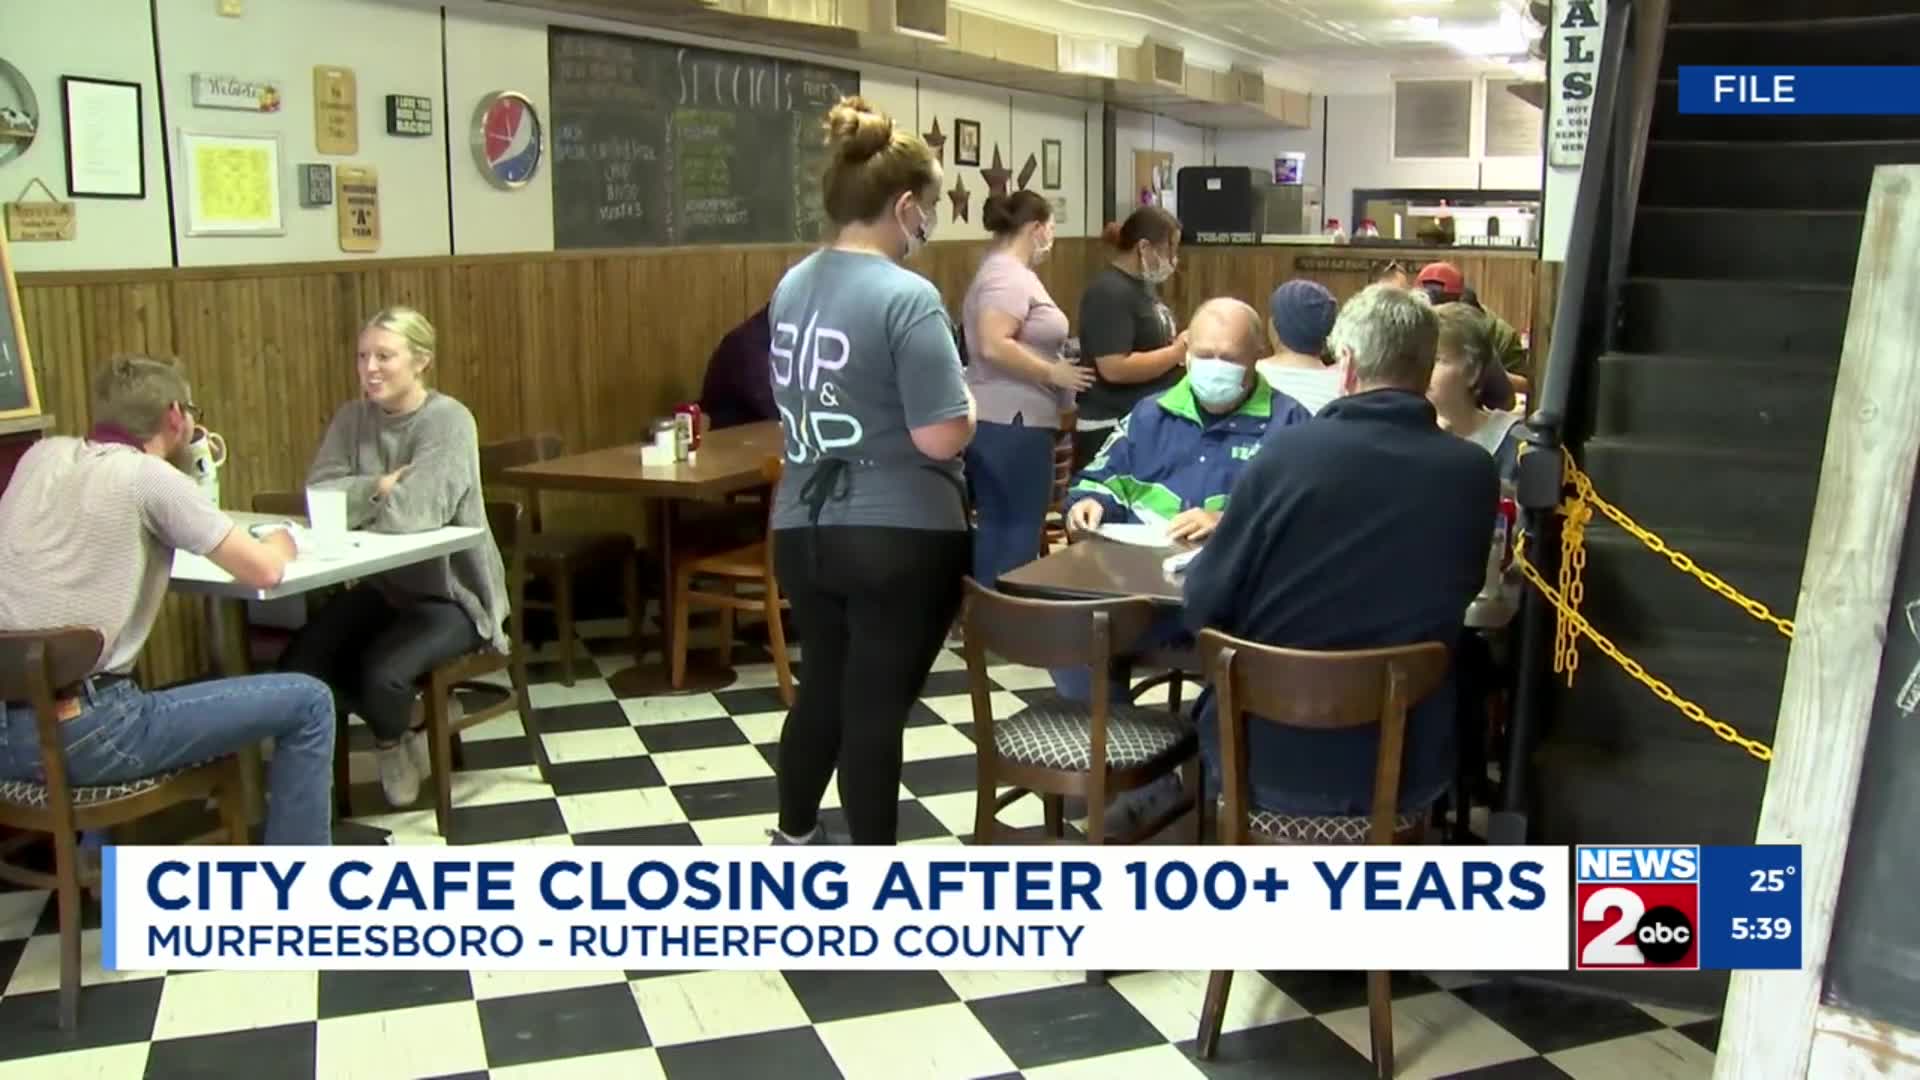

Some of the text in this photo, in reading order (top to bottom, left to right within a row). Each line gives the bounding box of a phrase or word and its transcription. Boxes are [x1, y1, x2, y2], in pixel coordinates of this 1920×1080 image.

[1566, 105, 1588, 114] HOT
[396, 120, 431, 134] BACON
[1555, 130, 1588, 139] SERV
[820, 382, 839, 406] &
